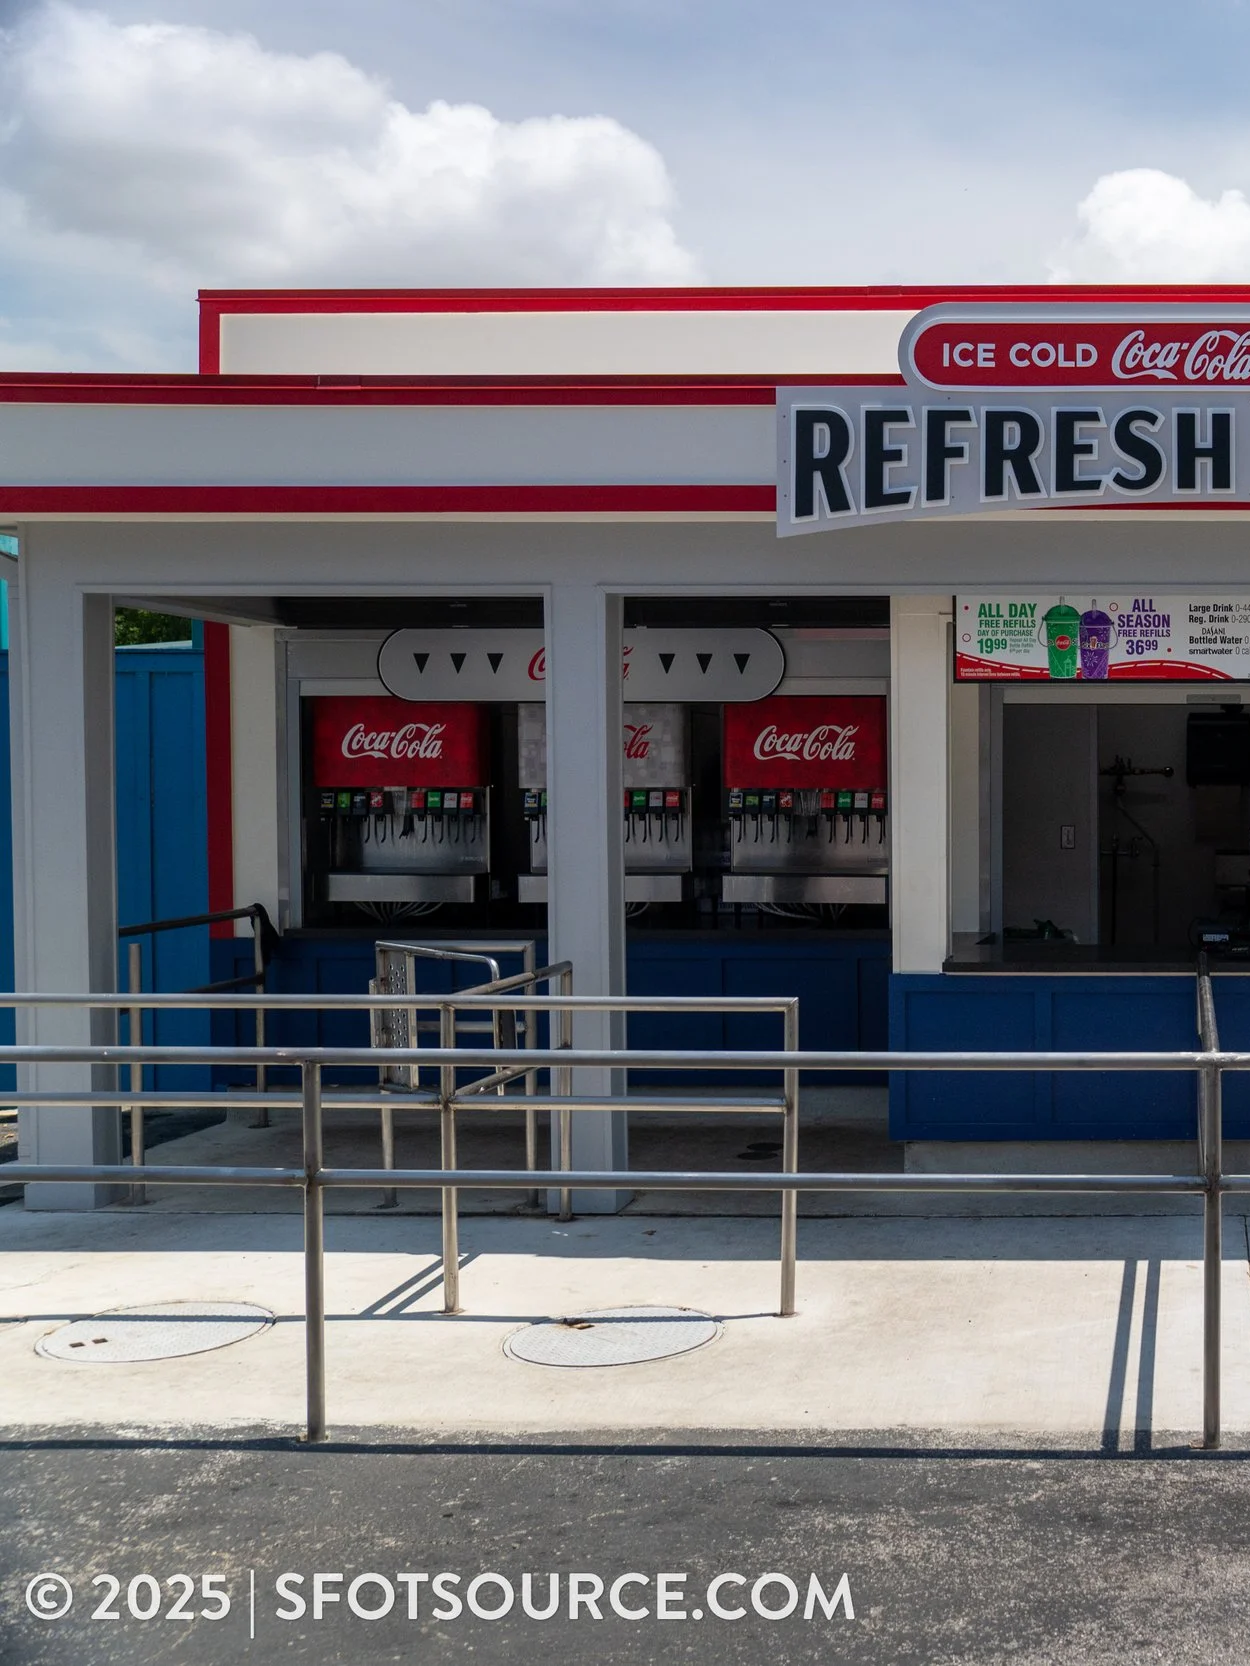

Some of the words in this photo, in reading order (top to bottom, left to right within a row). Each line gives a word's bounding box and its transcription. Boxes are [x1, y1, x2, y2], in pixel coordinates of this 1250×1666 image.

[943, 342, 996, 368] ICE
[1009, 342, 1098, 368] COLD
[795, 409, 1232, 520] REFRESH
[978, 603, 1005, 618] ALL
[1008, 603, 1037, 618] DAY
[1132, 598, 1156, 613] ALL
[1188, 603, 1211, 614] Large
[1212, 603, 1234, 612] Drink
[979, 619, 1001, 628] FREE
[1003, 619, 1036, 628] REFILLS
[1117, 614, 1171, 628] SEASON
[1188, 614, 1206, 624] Reg.
[1208, 614, 1229, 623] Drink
[977, 629, 990, 637] DAY
[991, 629, 1000, 637] OF
[1001, 629, 1034, 637] PURCHASE
[1117, 629, 1138, 638] FREE
[1139, 629, 1171, 638] REFILLS
[1201, 626, 1226, 636] DASANI
[1189, 635, 1217, 644] Bottled
[1219, 635, 1243, 644] Water
[1244, 635, 1249, 644] 0
[1188, 647, 1233, 655] smartwater
[1235, 646, 1240, 655] 0
[1241, 646, 1250, 655] cal
[342, 723, 444, 759] Coca-Cola
[754, 725, 857, 761] Coca-Cola
